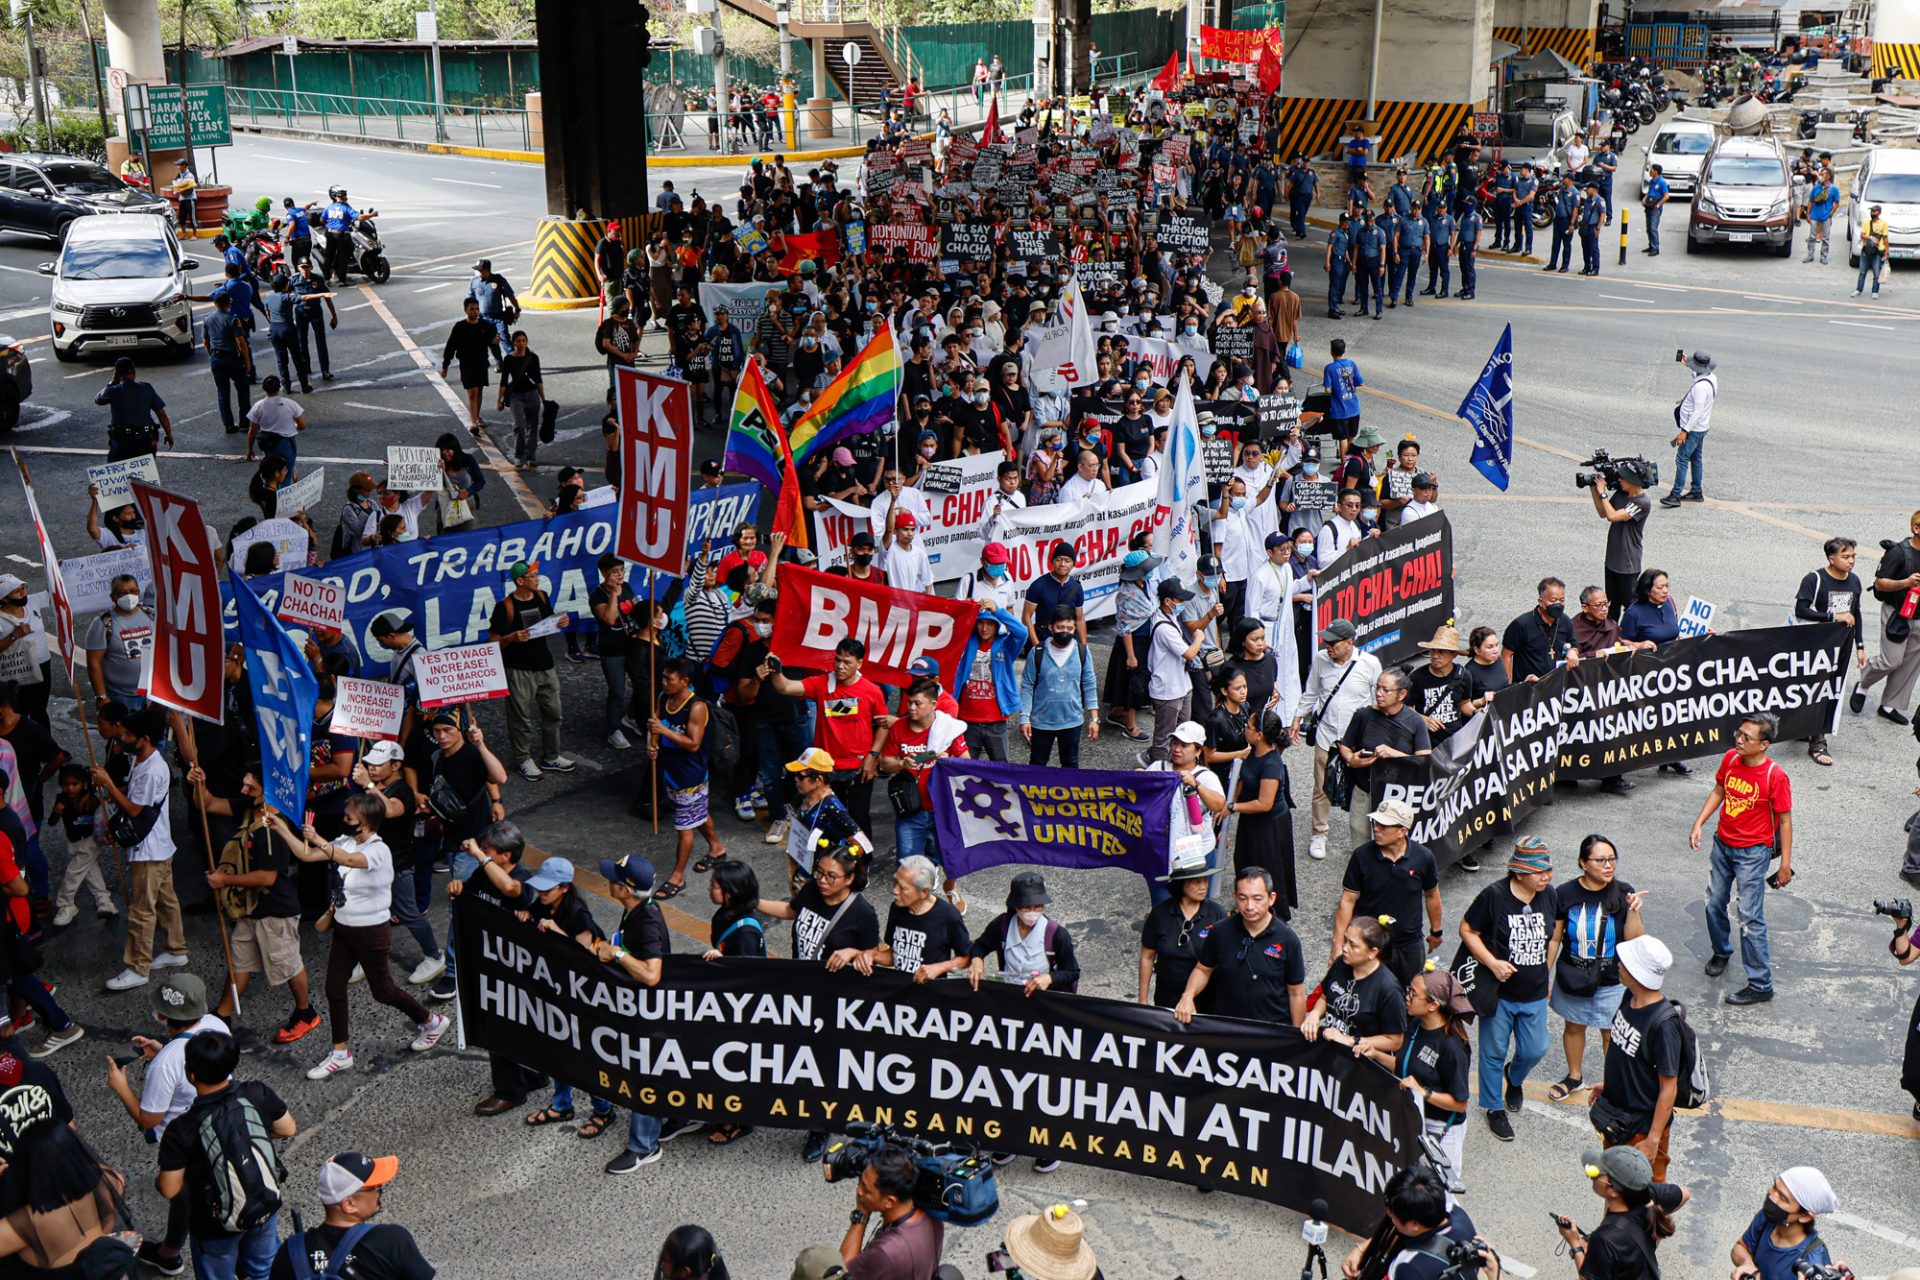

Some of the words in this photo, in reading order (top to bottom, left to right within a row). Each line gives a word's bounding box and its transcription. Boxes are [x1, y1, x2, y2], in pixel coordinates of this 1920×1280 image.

[200, 121, 223, 131] EAST
[169, 133, 220, 143] MANALUYONG
[951, 223, 966, 233] WE
[970, 225, 991, 235] SAY
[1160, 223, 1209, 237] THROUGH
[1171, 216, 1194, 226] NOT
[871, 225, 928, 241] KOMUNIDAD
[954, 234, 970, 242] NO
[973, 234, 988, 243] TO
[1013, 231, 1034, 240] NOT
[1037, 231, 1051, 240] AT
[1157, 233, 1209, 247] DECEPTION
[946, 243, 992, 254] CHACHA
[1017, 240, 1044, 248] THIS
[1017, 248, 1046, 256] TIME
[1095, 262, 1111, 271] FOR
[1112, 261, 1126, 270] THE
[1261, 414, 1268, 422] NO
[1269, 411, 1277, 421] TO
[105, 463, 127, 475] FIRST
[129, 457, 151, 469] STEP
[633, 378, 676, 560] KMU
[1097, 510, 1106, 521] at
[408, 521, 612, 587] TRABAHO
[293, 580, 313, 597] NO
[318, 585, 337, 604] TO
[1336, 584, 1355, 622] TO
[1357, 549, 1443, 618] CHA-CHA!
[149, 496, 208, 700] KMU
[282, 595, 343, 623] CHACHA!
[1690, 599, 1712, 620] NO
[800, 585, 956, 668] BMP
[419, 654, 441, 665] YES
[443, 652, 458, 661] TO
[460, 646, 494, 659] WAGE
[430, 658, 489, 675] INCREASE!
[425, 676, 440, 686] NO
[441, 674, 455, 683] TO
[456, 668, 497, 681] MARCOS
[1563, 685, 1596, 715] SA
[1597, 663, 1692, 703] MARCOS
[1697, 647, 1841, 688] CHA-CHA!
[342, 680, 358, 692] YES
[360, 682, 372, 693] TO
[374, 684, 400, 698] WAGE
[442, 680, 484, 693] CHACHA!
[347, 694, 393, 708] INCREASE!
[341, 703, 352, 713] NO
[353, 705, 363, 715] TO
[364, 707, 396, 720] MARCOS
[350, 715, 383, 728] CHACHA!
[1506, 748, 1531, 782] SA
[1661, 676, 1842, 728] DEMOKRASYA!
[1604, 728, 1720, 764] MAKABAYAN
[1019, 783, 1137, 804] WOMEN
[1727, 776, 1753, 795] BMP
[1031, 800, 1143, 838] WORKERS
[1032, 823, 1128, 857] UNITED
[1508, 912, 1546, 929] NEVER
[893, 926, 927, 948] NEVER
[1509, 925, 1548, 941] AGAIN.
[893, 941, 924, 962] AGAIN.
[1509, 939, 1546, 953] NEVER
[481, 929, 562, 996] LUPA,
[569, 969, 824, 1034] KABUHAYAN,
[836, 998, 1082, 1062] KARAPATAN
[1090, 1032, 1147, 1070] AT
[1155, 1040, 1401, 1154] KASARINLAN,
[479, 973, 582, 1051] HINDI
[591, 1026, 826, 1088] CHA-CHA
[837, 1048, 917, 1095] NG
[929, 1057, 1187, 1138] DAYUHAN
[1198, 1102, 1271, 1151] AT
[599, 1071, 743, 1113] BAGONG
[770, 1098, 1003, 1140] ALYANSANG
[1028, 1127, 1271, 1188] MAKABAYAN
